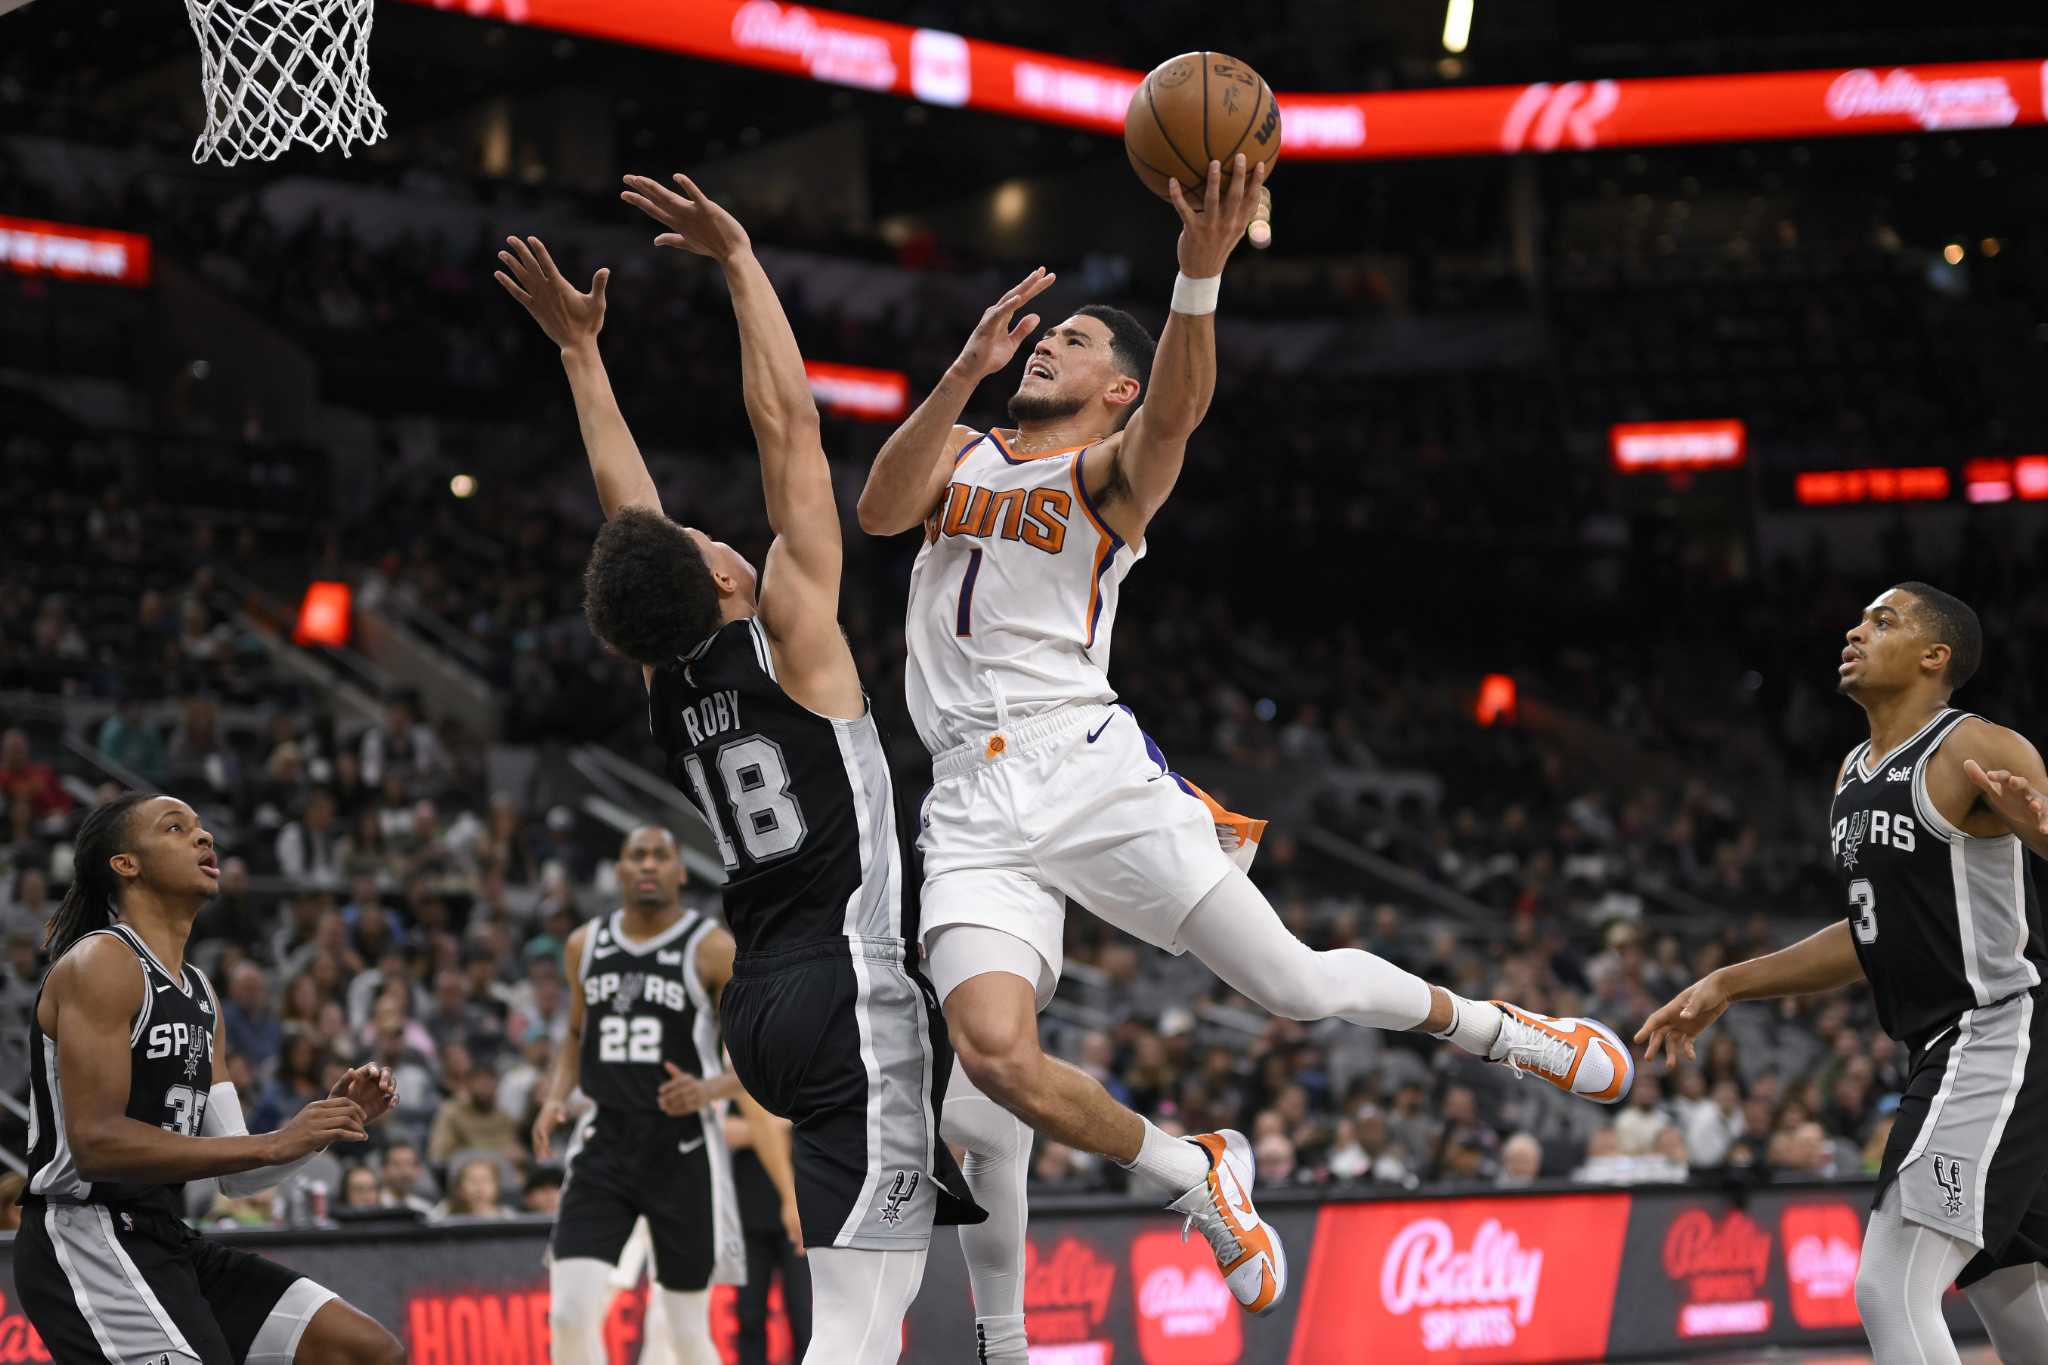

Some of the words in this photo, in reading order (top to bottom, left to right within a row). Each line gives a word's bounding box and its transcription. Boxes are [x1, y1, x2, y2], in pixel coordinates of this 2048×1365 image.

[955, 548, 983, 637] 1
[681, 689, 741, 747] ROBY
[683, 733, 808, 870] 18
[1849, 878, 1878, 944] 3
[584, 972, 685, 1012] SPURS
[599, 1015, 662, 1063] 22
[1380, 1217, 1543, 1327] Bally
[1420, 1304, 1516, 1351] SPORTS
